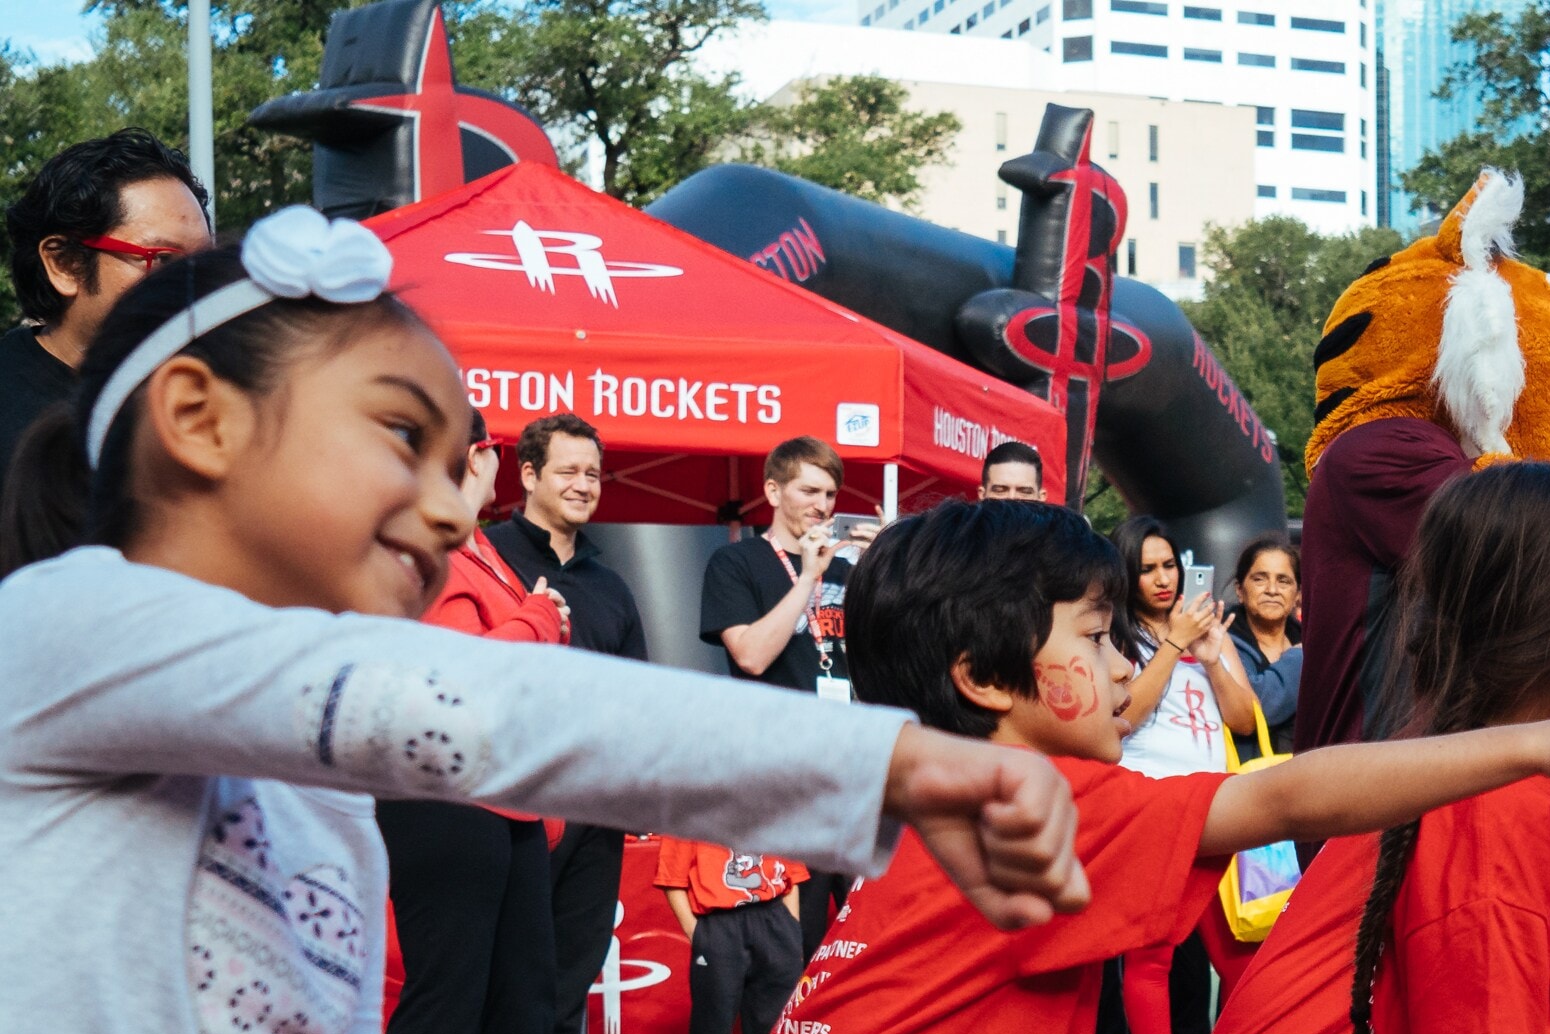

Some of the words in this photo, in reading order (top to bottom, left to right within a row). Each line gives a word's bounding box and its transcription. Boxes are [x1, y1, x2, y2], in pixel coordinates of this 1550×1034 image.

[750, 217, 826, 281] TON
[459, 367, 574, 413] STON
[587, 367, 782, 424] ROCKETS
[933, 405, 988, 459] HOUSTON
[818, 618, 846, 638] RU
